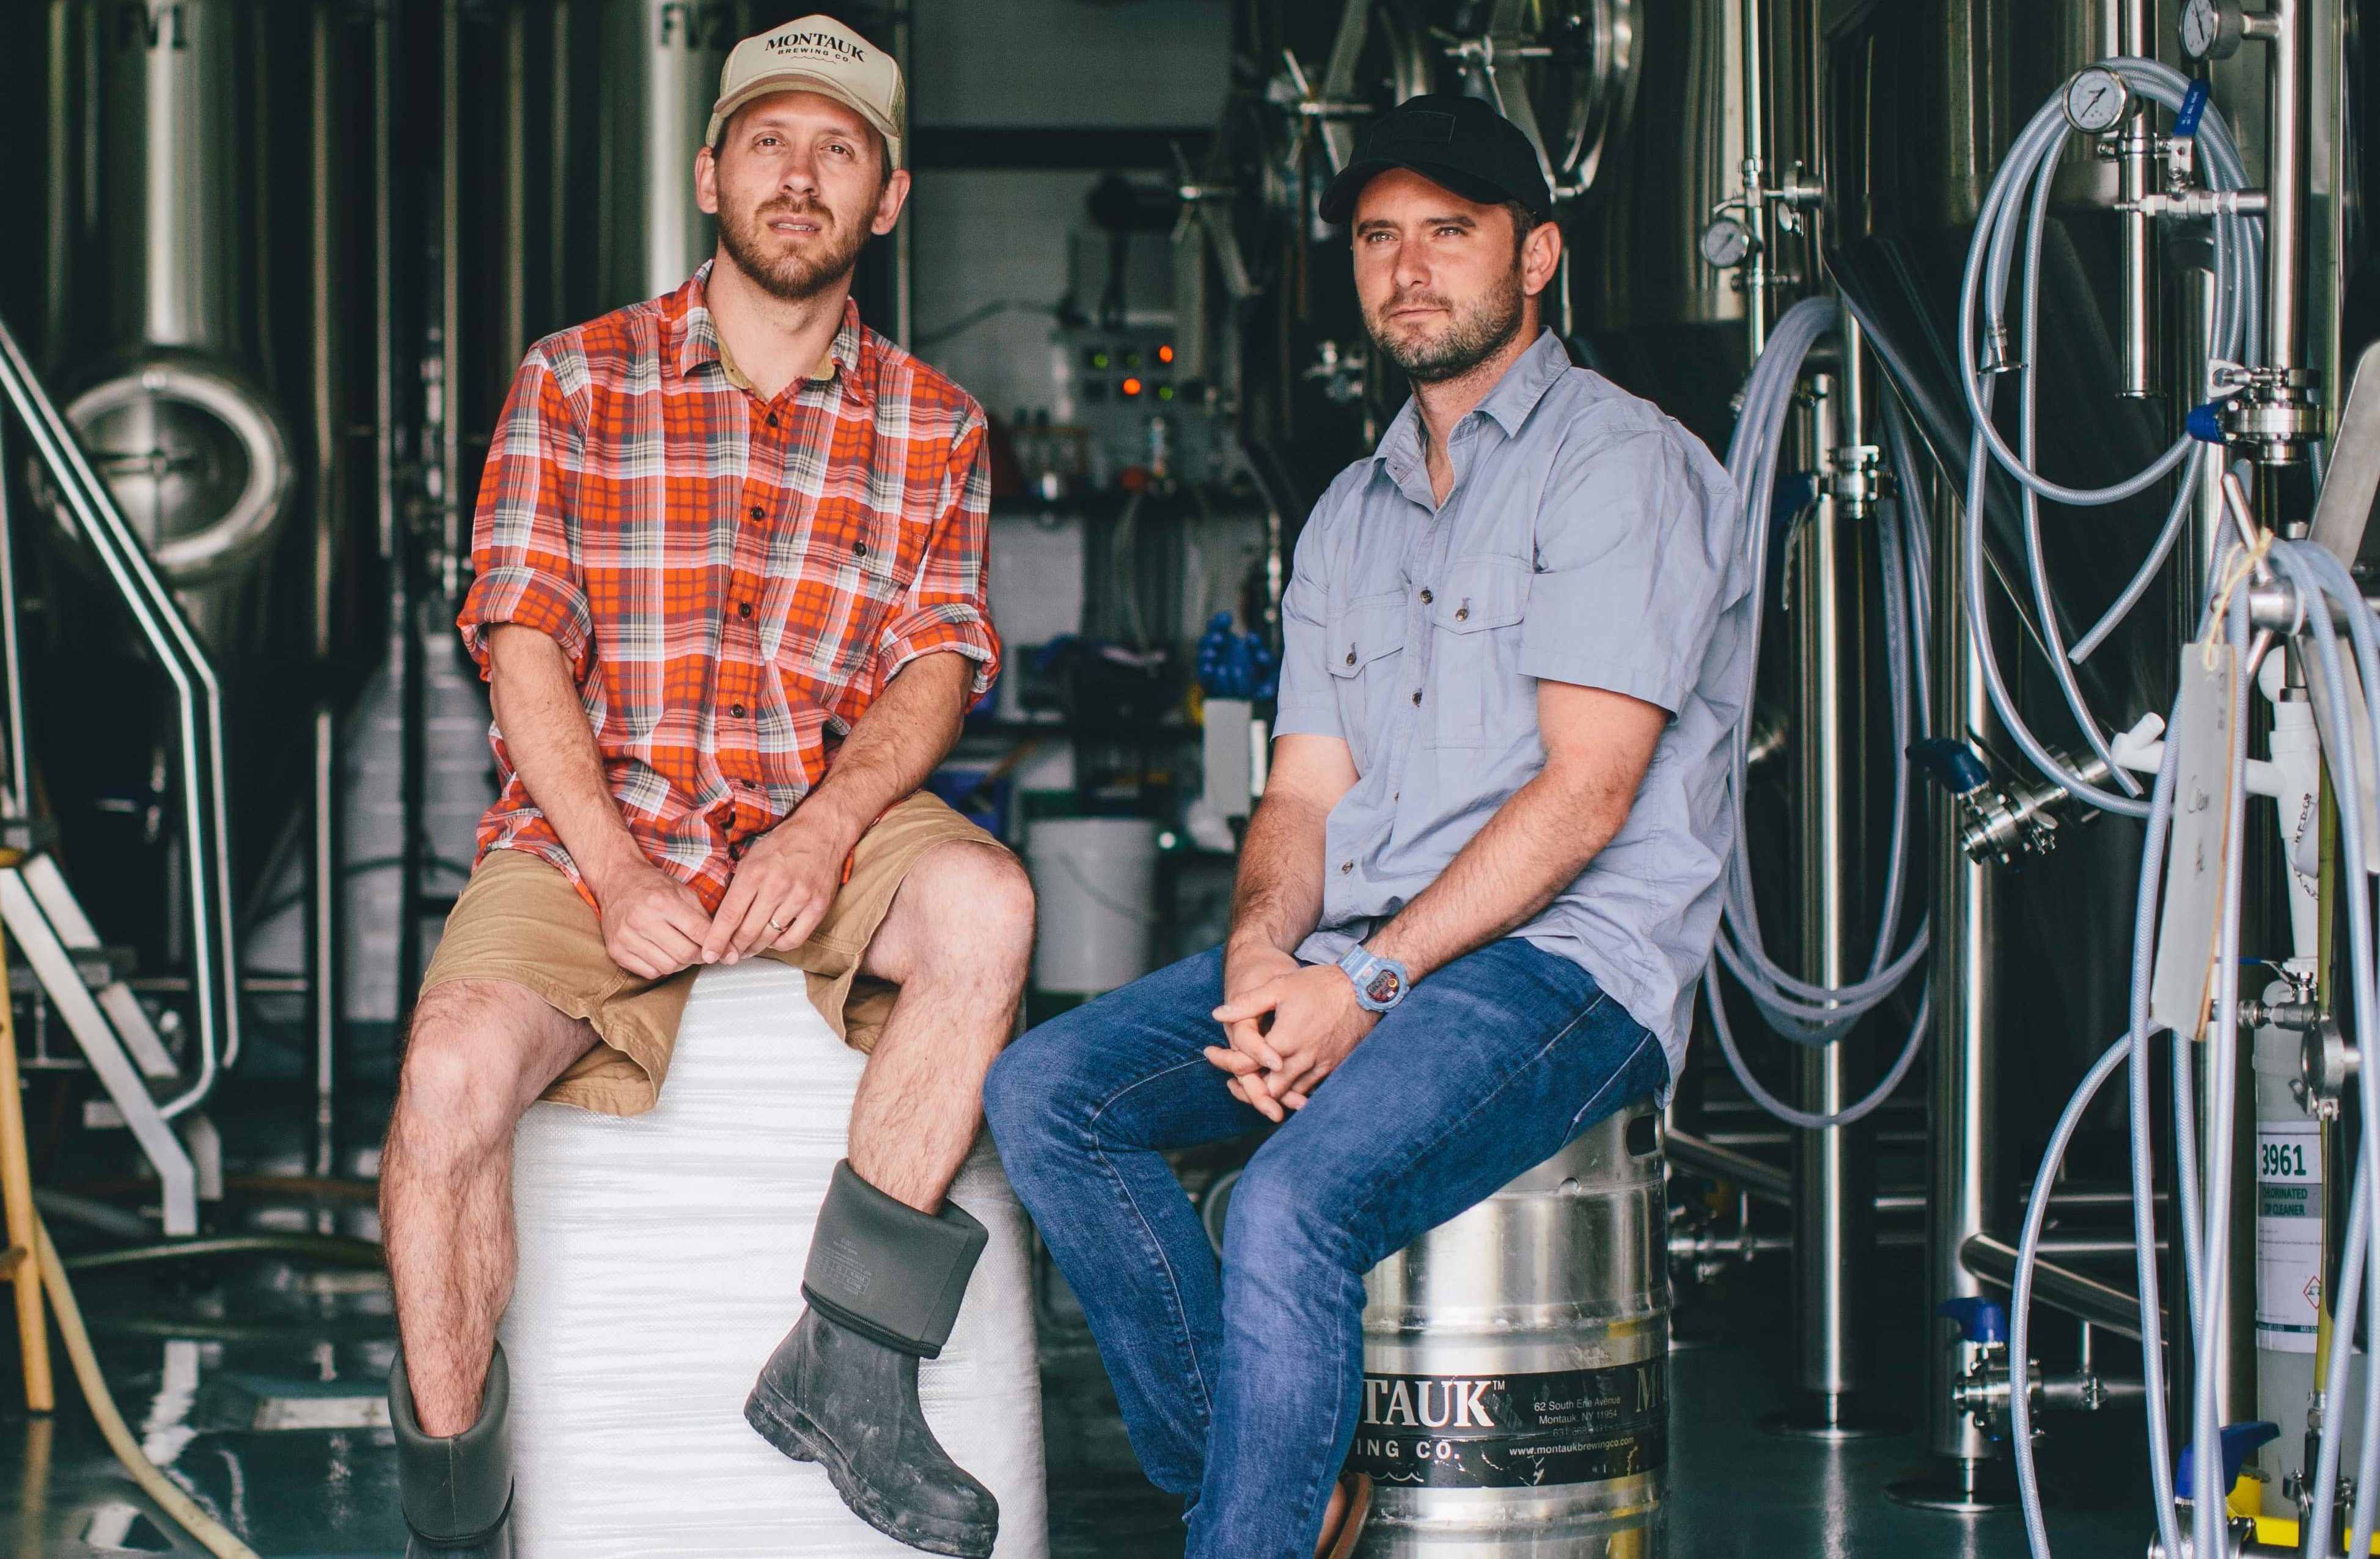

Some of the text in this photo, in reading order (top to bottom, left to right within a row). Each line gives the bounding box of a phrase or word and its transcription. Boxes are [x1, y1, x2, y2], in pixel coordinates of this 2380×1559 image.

[765, 33, 866, 63] MONTAUK
[778, 47, 851, 64] BREWING CO.
[2263, 1143, 2307, 1176] 3961
[2273, 1203, 2305, 1216] CLEANER
[1534, 1402, 1546, 1412] 62
[1549, 1400, 1574, 1410] South
[1594, 1396, 1621, 1406] Avenue
[1582, 1412, 1594, 1421] NY
[1596, 1408, 1617, 1419] 11954
[1356, 1438, 1460, 1460] ING CO.
[1509, 1436, 1634, 1456] www.montaukbrewingco.com
